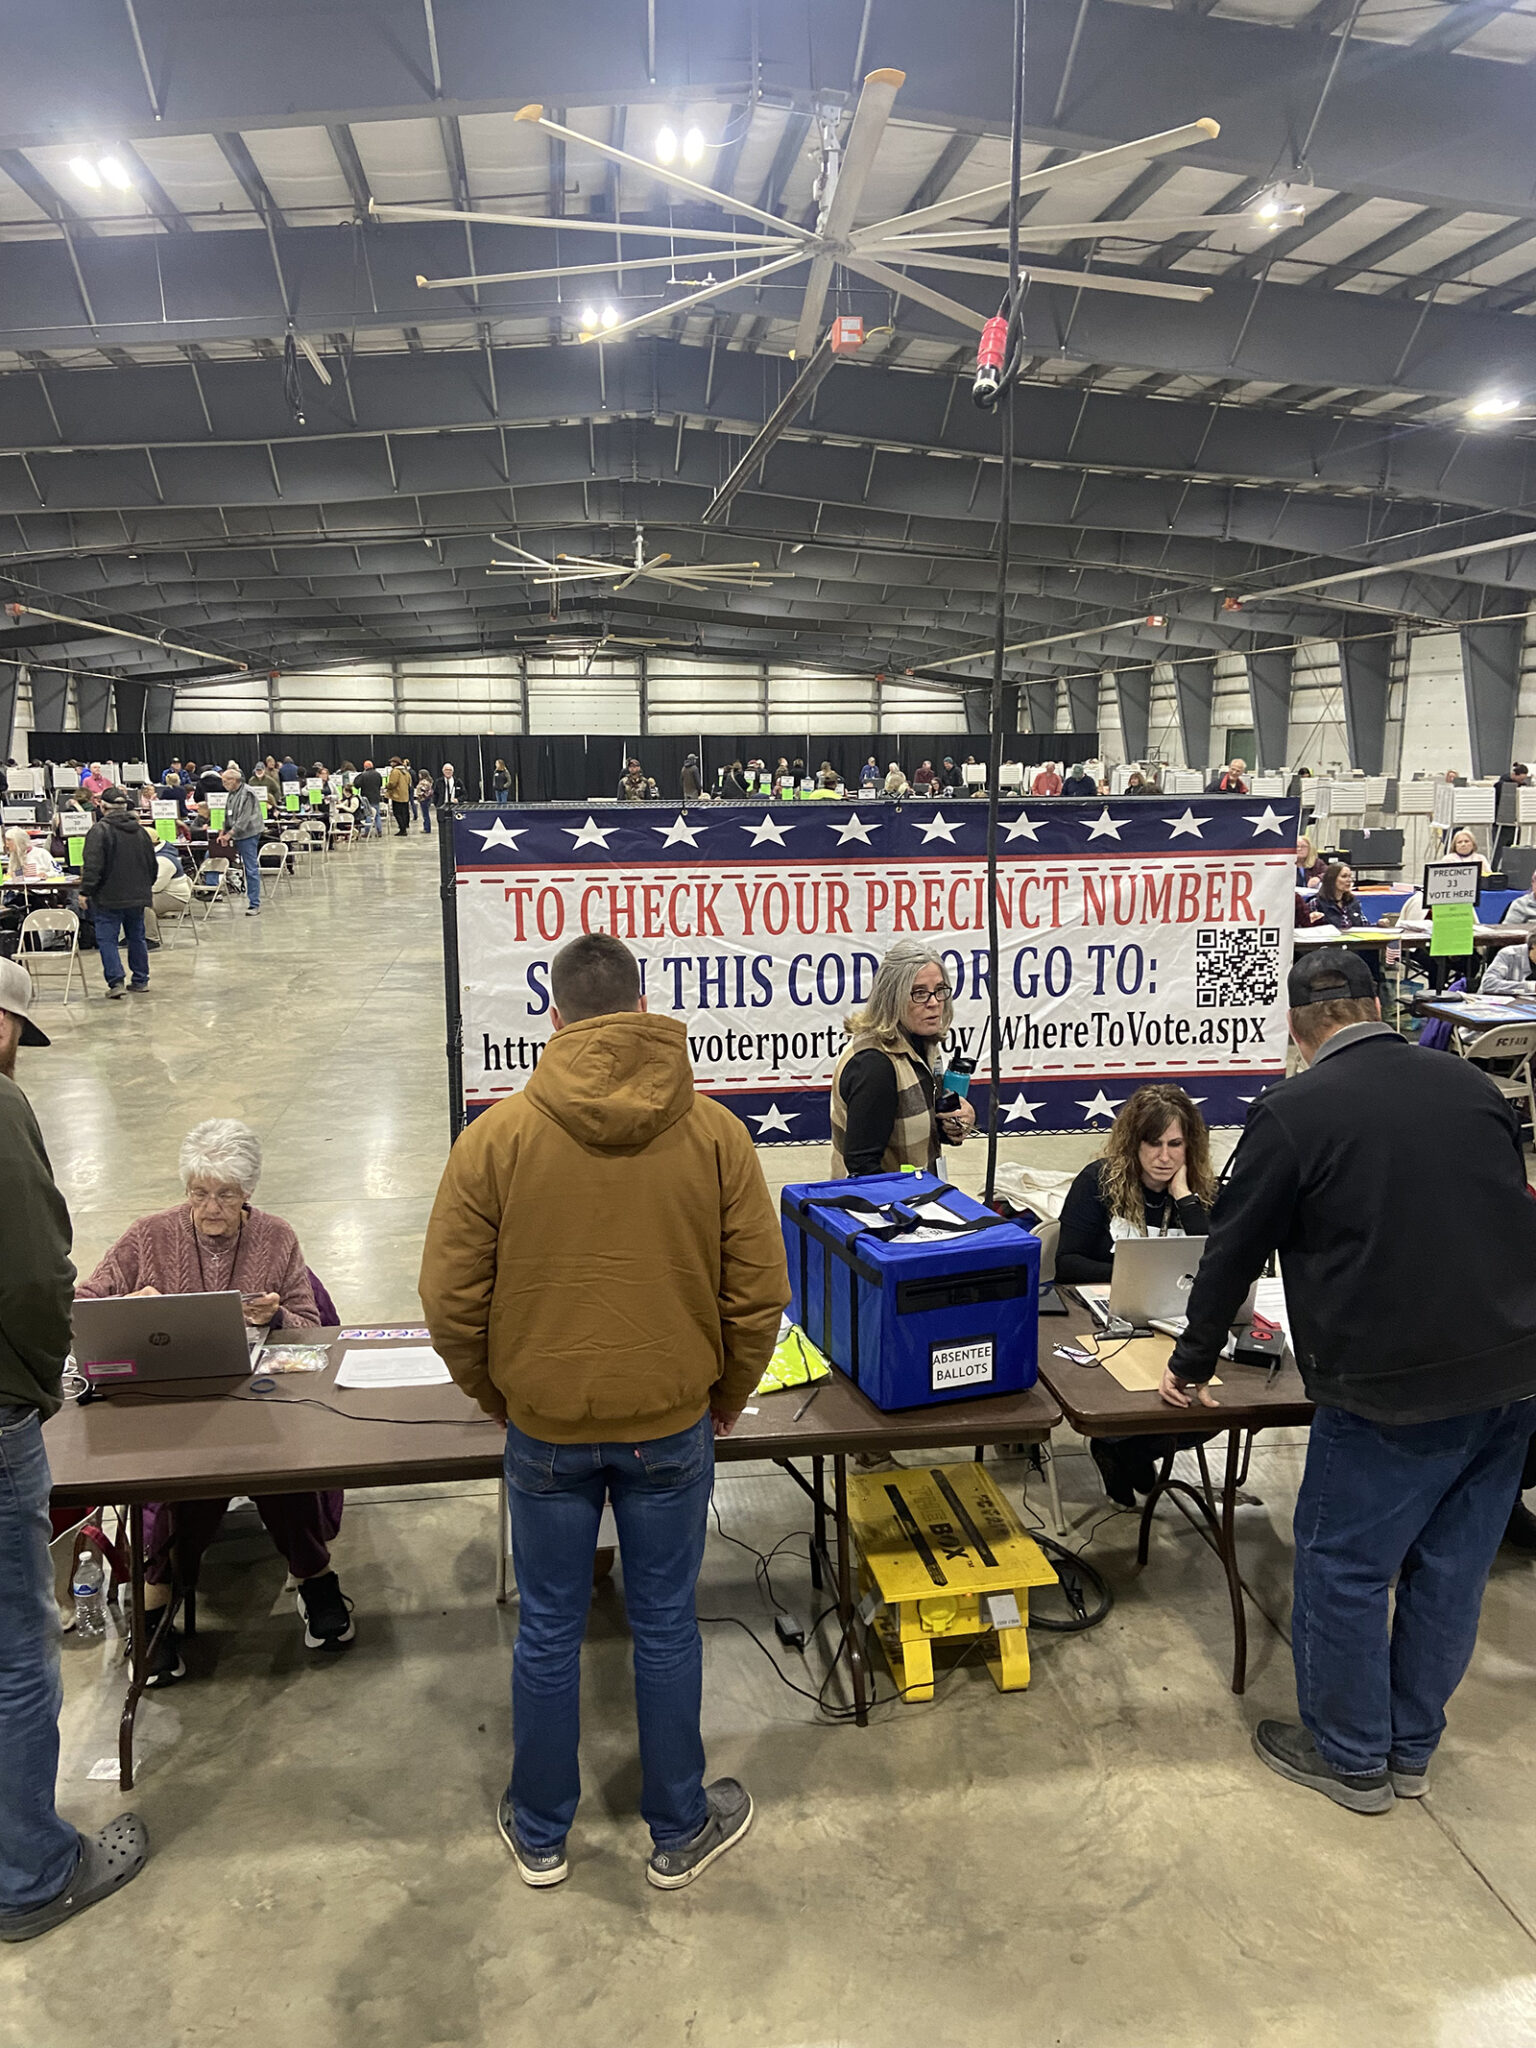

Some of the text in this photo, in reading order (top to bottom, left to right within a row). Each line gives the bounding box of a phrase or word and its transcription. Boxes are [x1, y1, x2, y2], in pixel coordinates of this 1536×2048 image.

[1433, 868, 1473, 877] PRECINCT
[1446, 879, 1458, 888] 33
[1429, 890, 1475, 899] VOTE HERE
[504, 871, 1267, 942] TO CHECK YOUR PRECINCT NUMBER,
[663, 954, 773, 1010] THIS
[788, 952, 880, 1006] COD
[940, 949, 992, 1000] OR
[1012, 945, 1073, 999] GO
[1087, 943, 1157, 996] TO:
[932, 1346, 992, 1365] ABSENTEE
[936, 1362, 988, 1381] BALLOTS
[908, 1484, 948, 1522] THE
[928, 1522, 970, 1561] BOX
